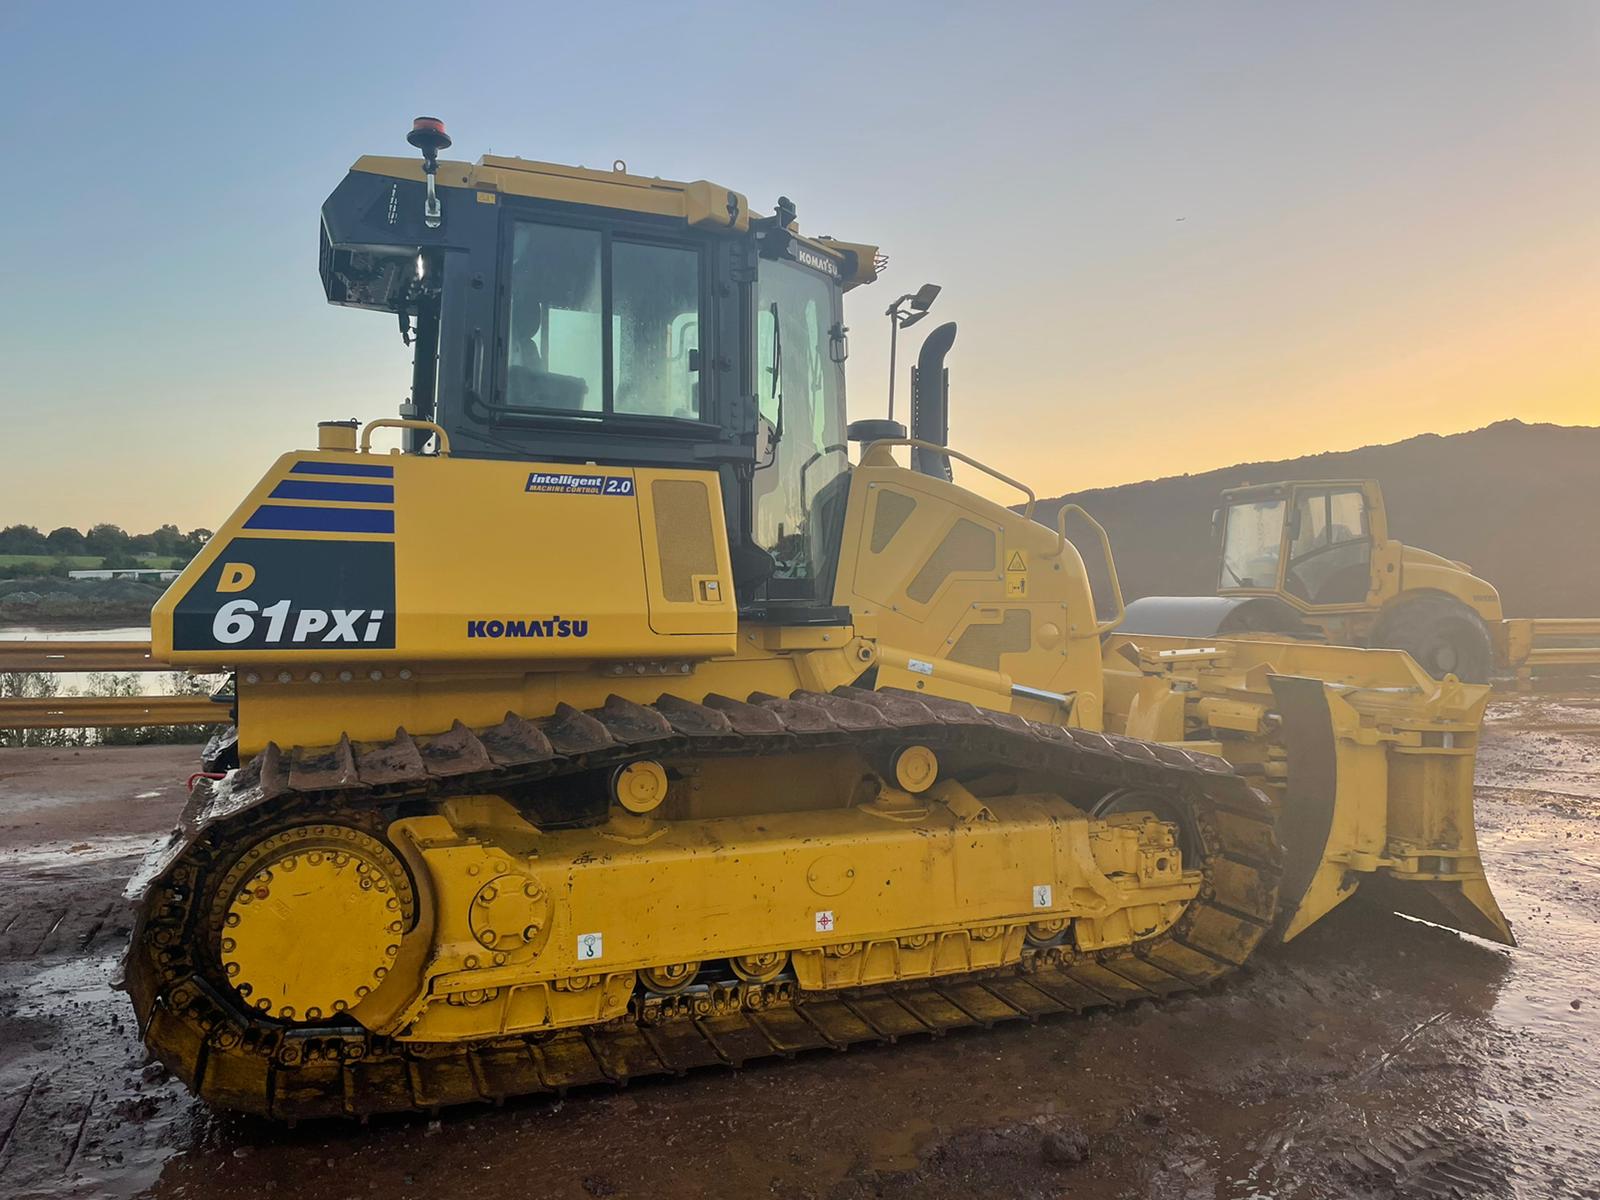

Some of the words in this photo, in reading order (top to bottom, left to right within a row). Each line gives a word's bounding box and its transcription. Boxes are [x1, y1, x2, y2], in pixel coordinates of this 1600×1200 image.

[799, 250, 838, 276] KOMATSU
[531, 474, 602, 487] intelligent
[565, 486, 600, 494] CONTROL
[606, 480, 631, 493] 2.0
[215, 562, 256, 593] D
[212, 599, 384, 644] 61PXi
[467, 615, 588, 638] KOMATSU
